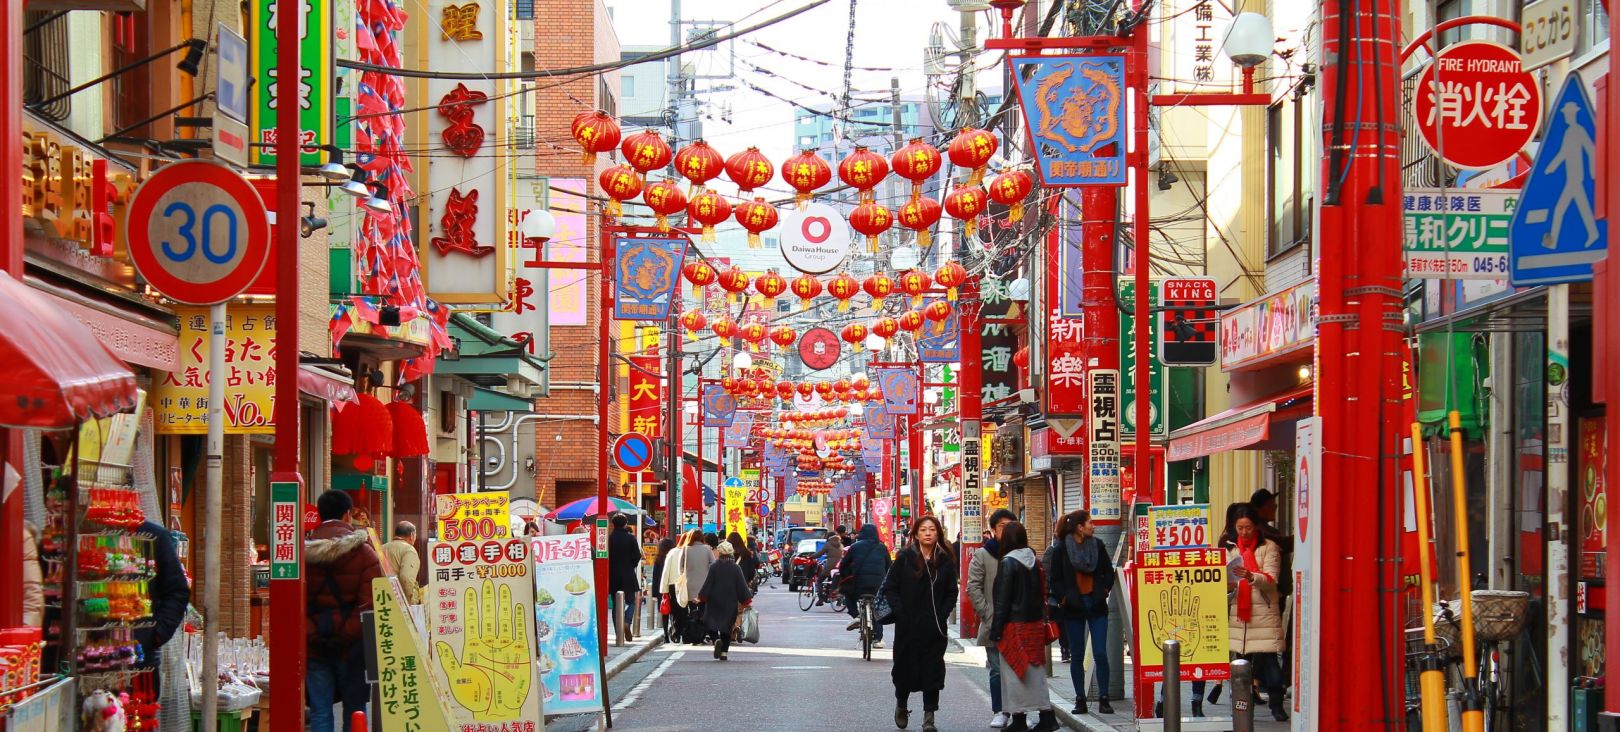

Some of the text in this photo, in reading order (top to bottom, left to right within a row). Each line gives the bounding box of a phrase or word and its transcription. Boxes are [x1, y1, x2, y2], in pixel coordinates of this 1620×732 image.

[1525, 9, 1571, 54] ここから
[1438, 58, 1521, 73] FIRE HYDRANT
[1426, 81, 1531, 130] 消火栓
[1050, 160, 1119, 178] 関帝廟通り
[161, 202, 237, 264] 30
[792, 245, 839, 254] Daiwa House
[804, 253, 826, 261] Group
[1167, 281, 1209, 289] SNACK
[1170, 289, 1213, 299] KING
[454, 496, 507, 509] キャンペーン
[275, 504, 294, 560] 関帝廟
[1156, 525, 1204, 546] ¥500
[436, 543, 525, 563] 開運手相
[1144, 551, 1221, 566] 開運手相
[376, 589, 399, 715] 小さなきっかけで
[401, 656, 421, 732] 運は近づい
